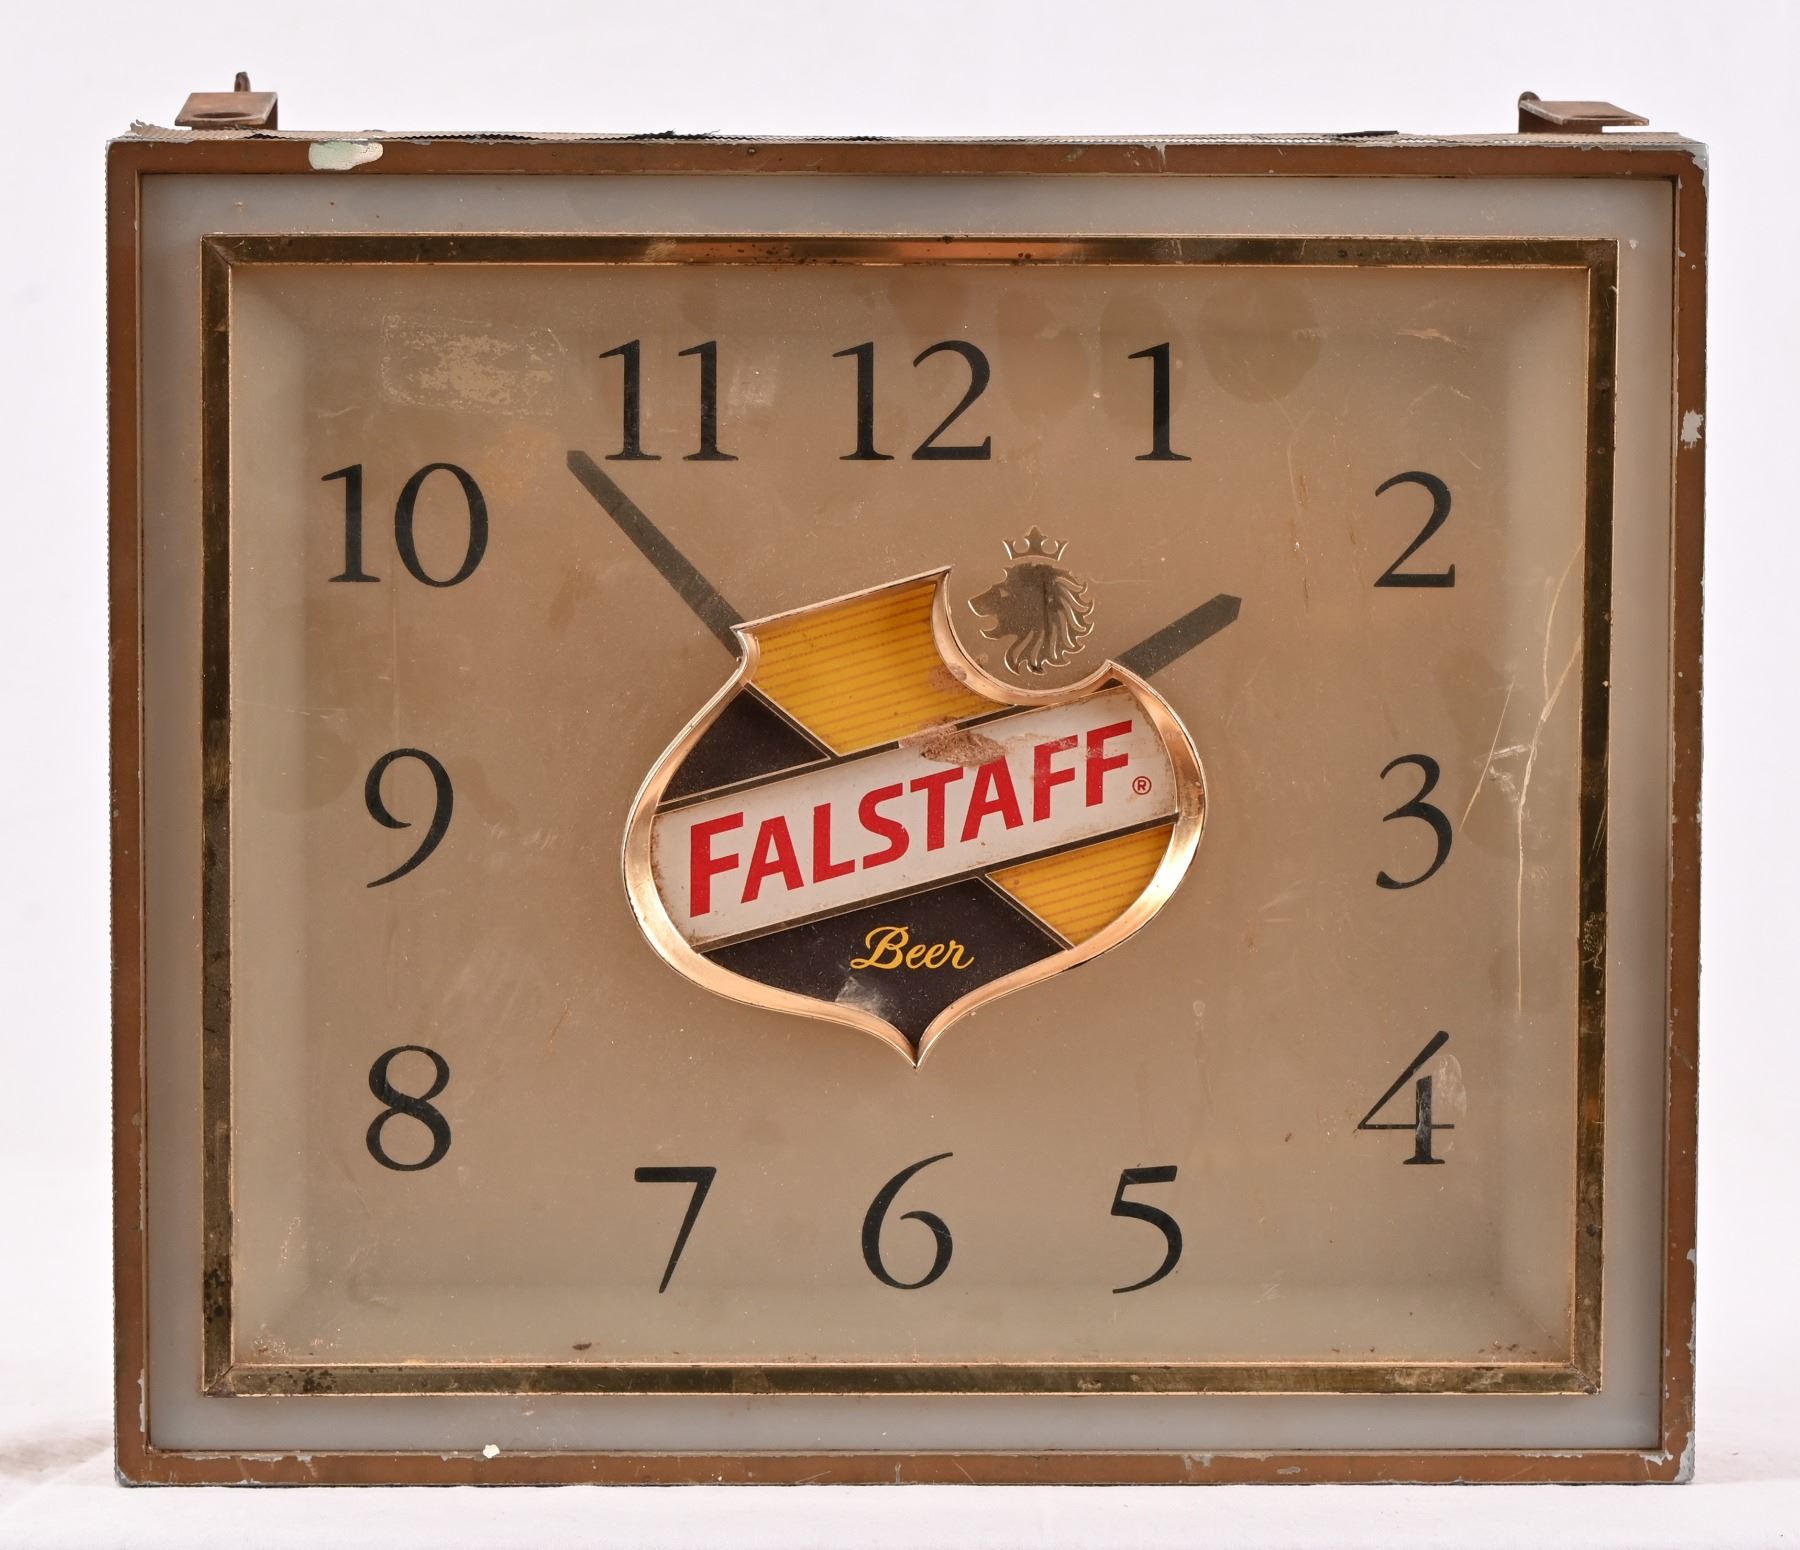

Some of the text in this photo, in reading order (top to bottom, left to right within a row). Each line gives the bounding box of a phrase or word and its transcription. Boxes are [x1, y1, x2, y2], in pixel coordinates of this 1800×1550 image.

[599, 339, 738, 461] 11
[832, 340, 991, 460] 12
[1128, 342, 1191, 460] 1
[321, 463, 488, 587] 10
[1374, 471, 1455, 587] 2
[365, 748, 453, 888] 9
[690, 720, 1133, 918] FALSTAFF
[1376, 754, 1452, 889] 3
[850, 925, 975, 970] Beer
[366, 1045, 451, 1171] 8
[1357, 1031, 1454, 1165] 4
[635, 1167, 716, 1293] 7
[862, 1153, 953, 1289] 6
[1111, 1166, 1182, 1293] 5
